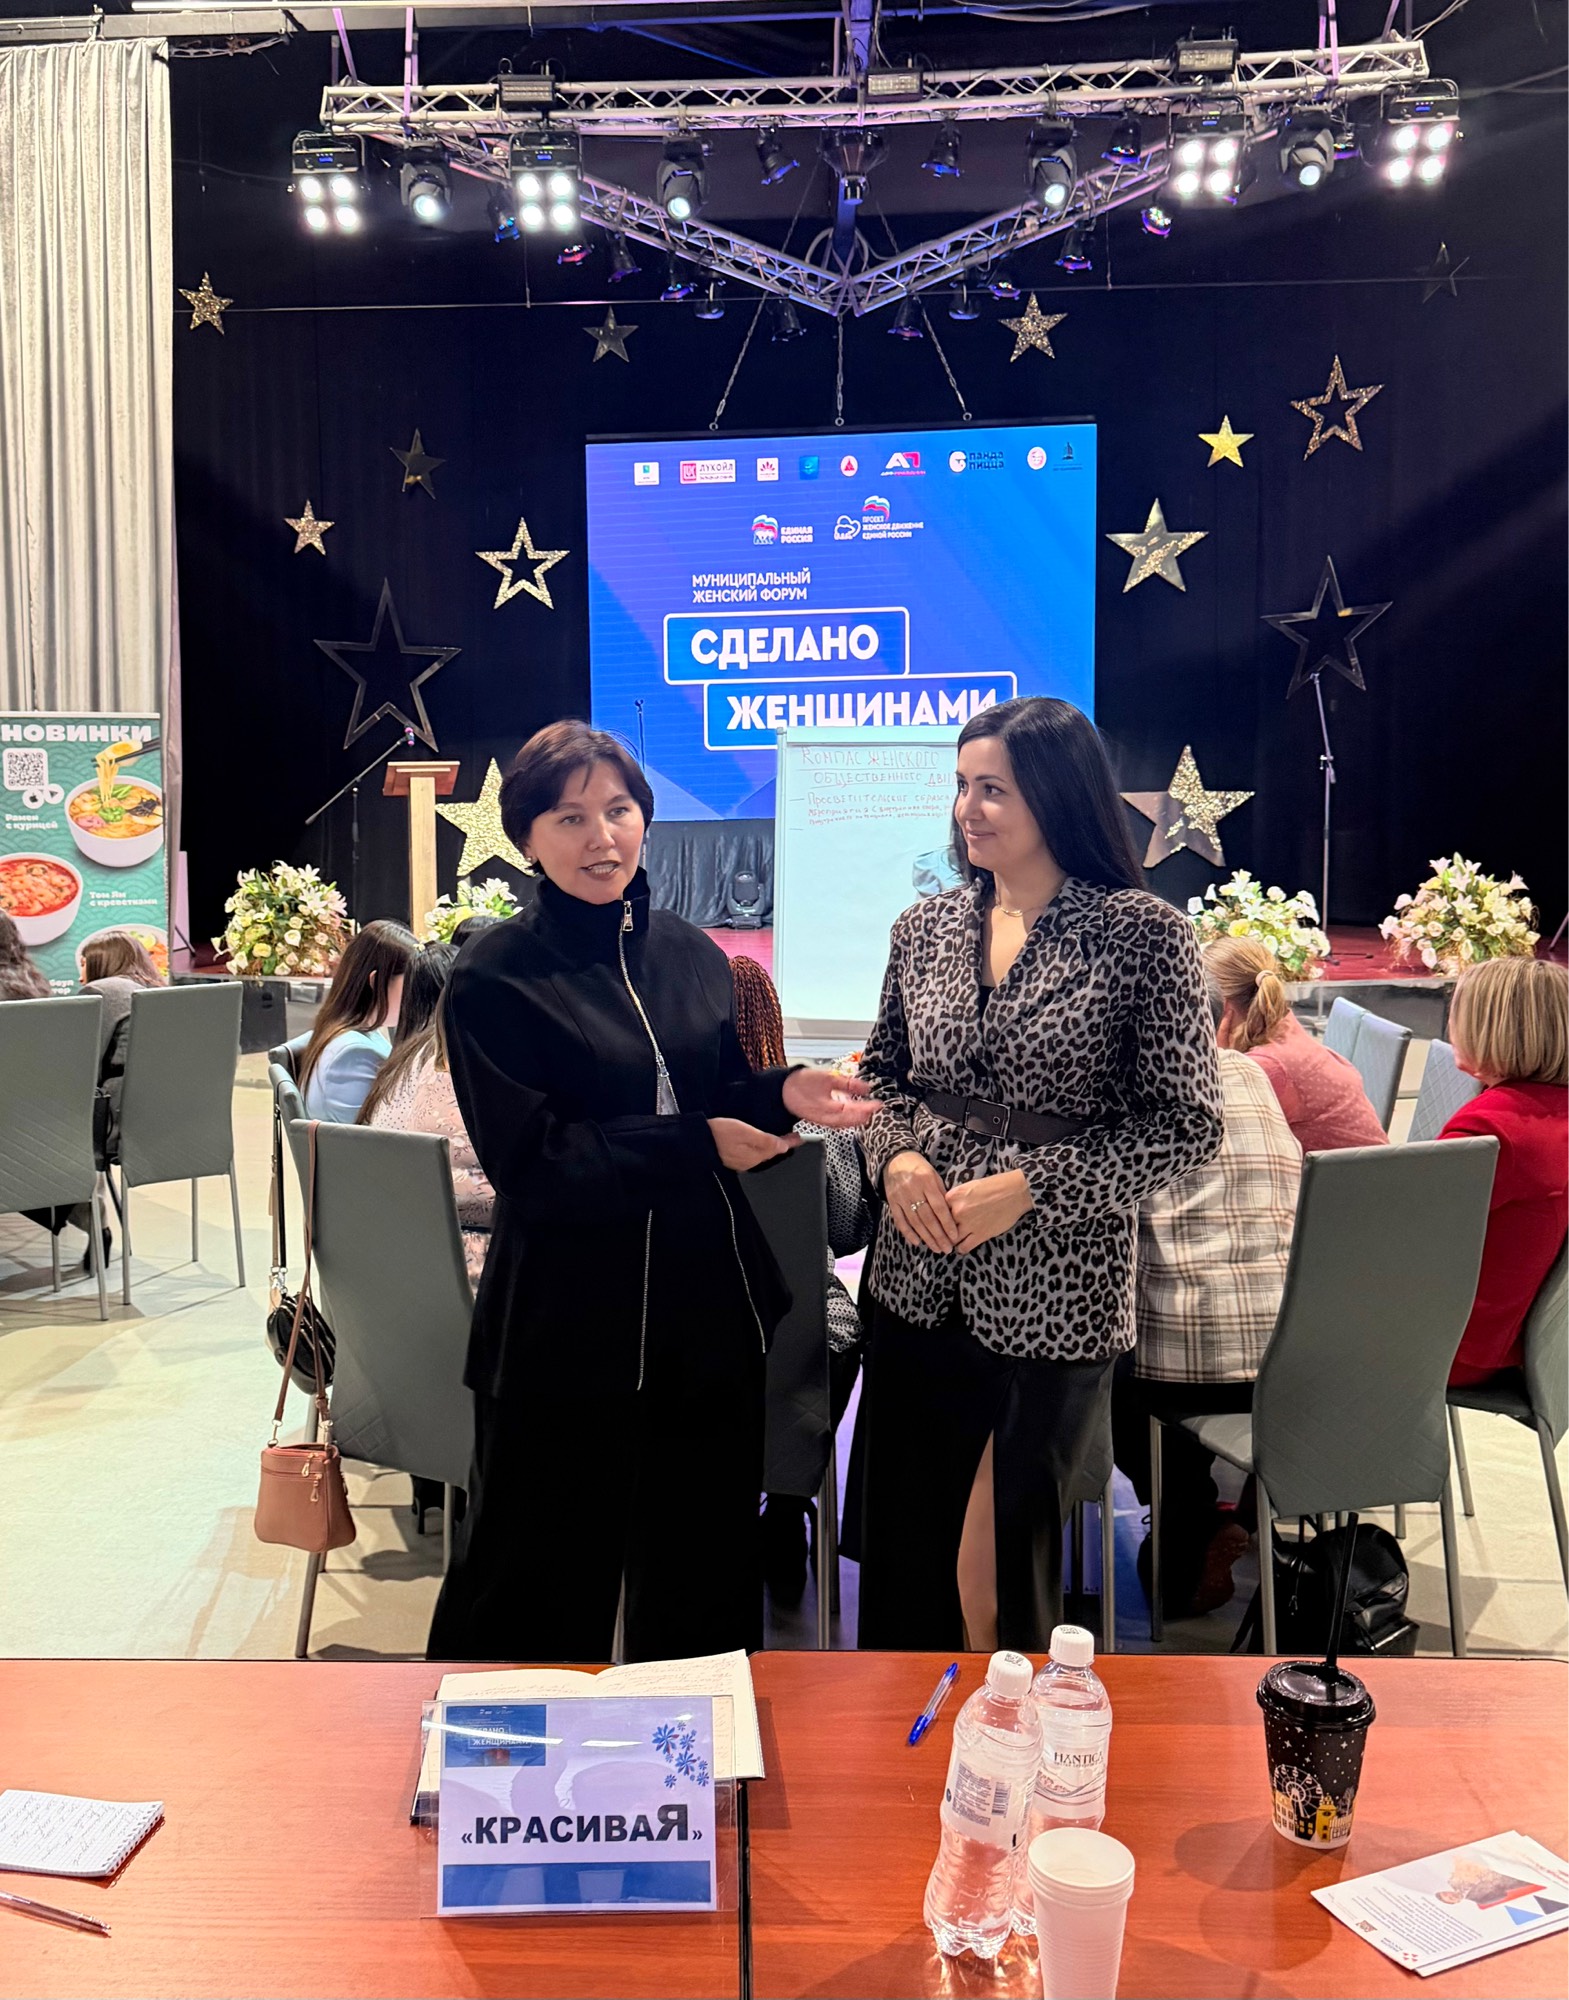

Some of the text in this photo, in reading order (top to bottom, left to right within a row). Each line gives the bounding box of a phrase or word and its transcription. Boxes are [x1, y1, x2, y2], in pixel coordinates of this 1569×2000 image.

[699, 461, 733, 472] ЛУКОЙЛ
[781, 526, 813, 535] ЕДИНАЯ
[781, 535, 813, 543] РОССИЯ
[692, 567, 811, 589] МУНИЦИПАЛЬНЫЙ
[692, 585, 807, 603] ЖЕНСКИЙ ФОРУМ
[691, 624, 879, 670] СДЕЛАНО
[1, 724, 152, 742] НОВИНКИ
[5, 813, 39, 822] Рамен
[13, 821, 58, 831] курицей
[89, 891, 110, 899] Том
[97, 898, 158, 908] креветками
[461, 1804, 703, 1845] «КРАСИВАЯ»
